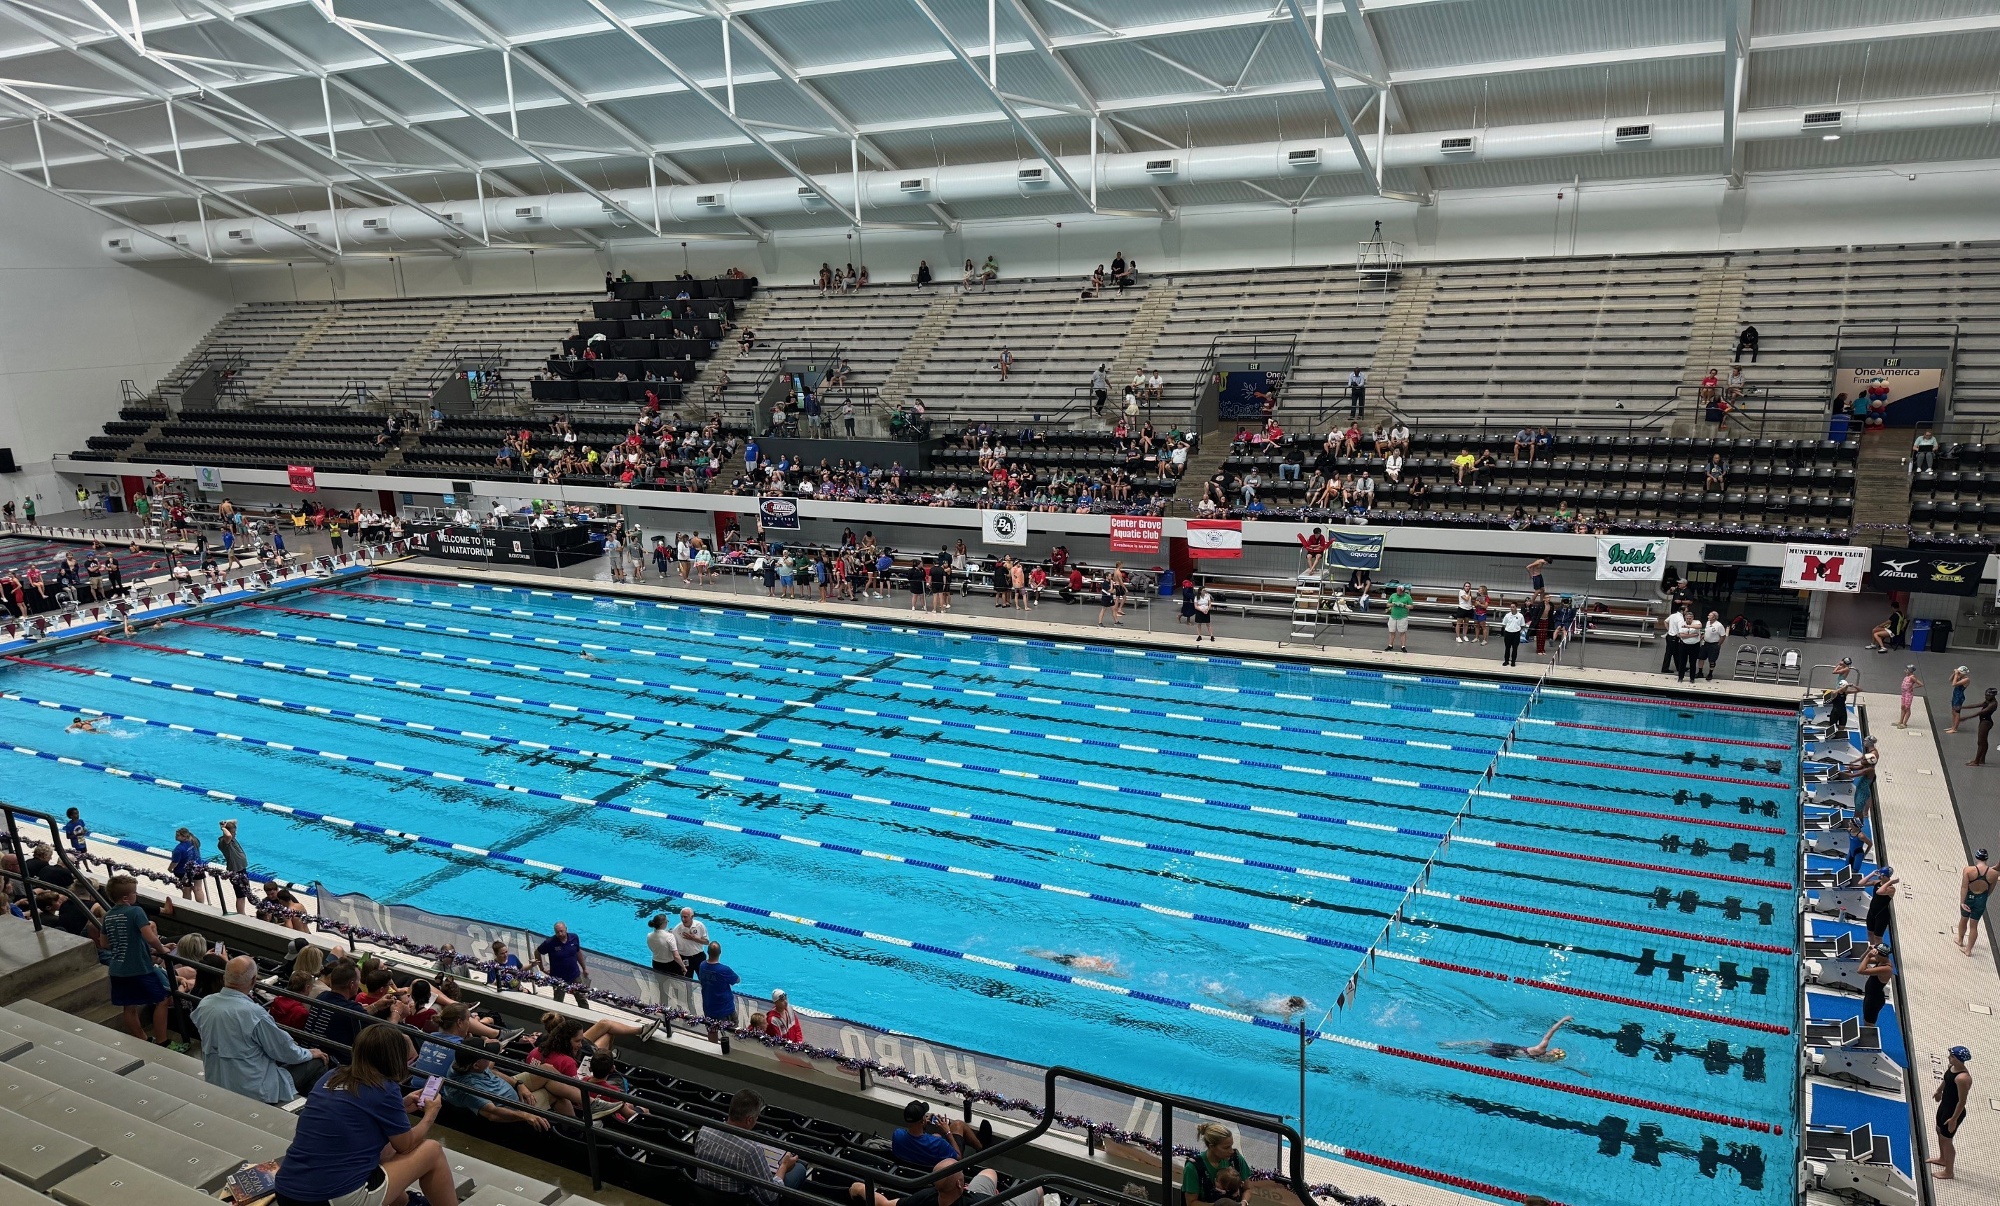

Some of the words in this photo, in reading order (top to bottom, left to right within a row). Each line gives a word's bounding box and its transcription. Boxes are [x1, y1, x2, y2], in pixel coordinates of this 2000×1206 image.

[1886, 358, 1899, 367] EXIT
[1854, 367, 1920, 376] OneAmerica
[997, 518, 1012, 532] BA
[1111, 518, 1137, 529] Center
[1138, 519, 1162, 530] Grove
[437, 534, 471, 545] WELCOME
[470, 536, 481, 545] TO
[481, 537, 497, 547] THE
[1113, 529, 1142, 539] Aquatic
[1142, 530, 1159, 540] Club
[442, 545, 449, 553] IU
[449, 546, 494, 557] NATATORIUM
[1608, 543, 1657, 565] Irish
[1788, 548, 1822, 556] MUNSTER
[1801, 555, 1845, 583] M
[1879, 569, 1918, 579] MIZUNO
